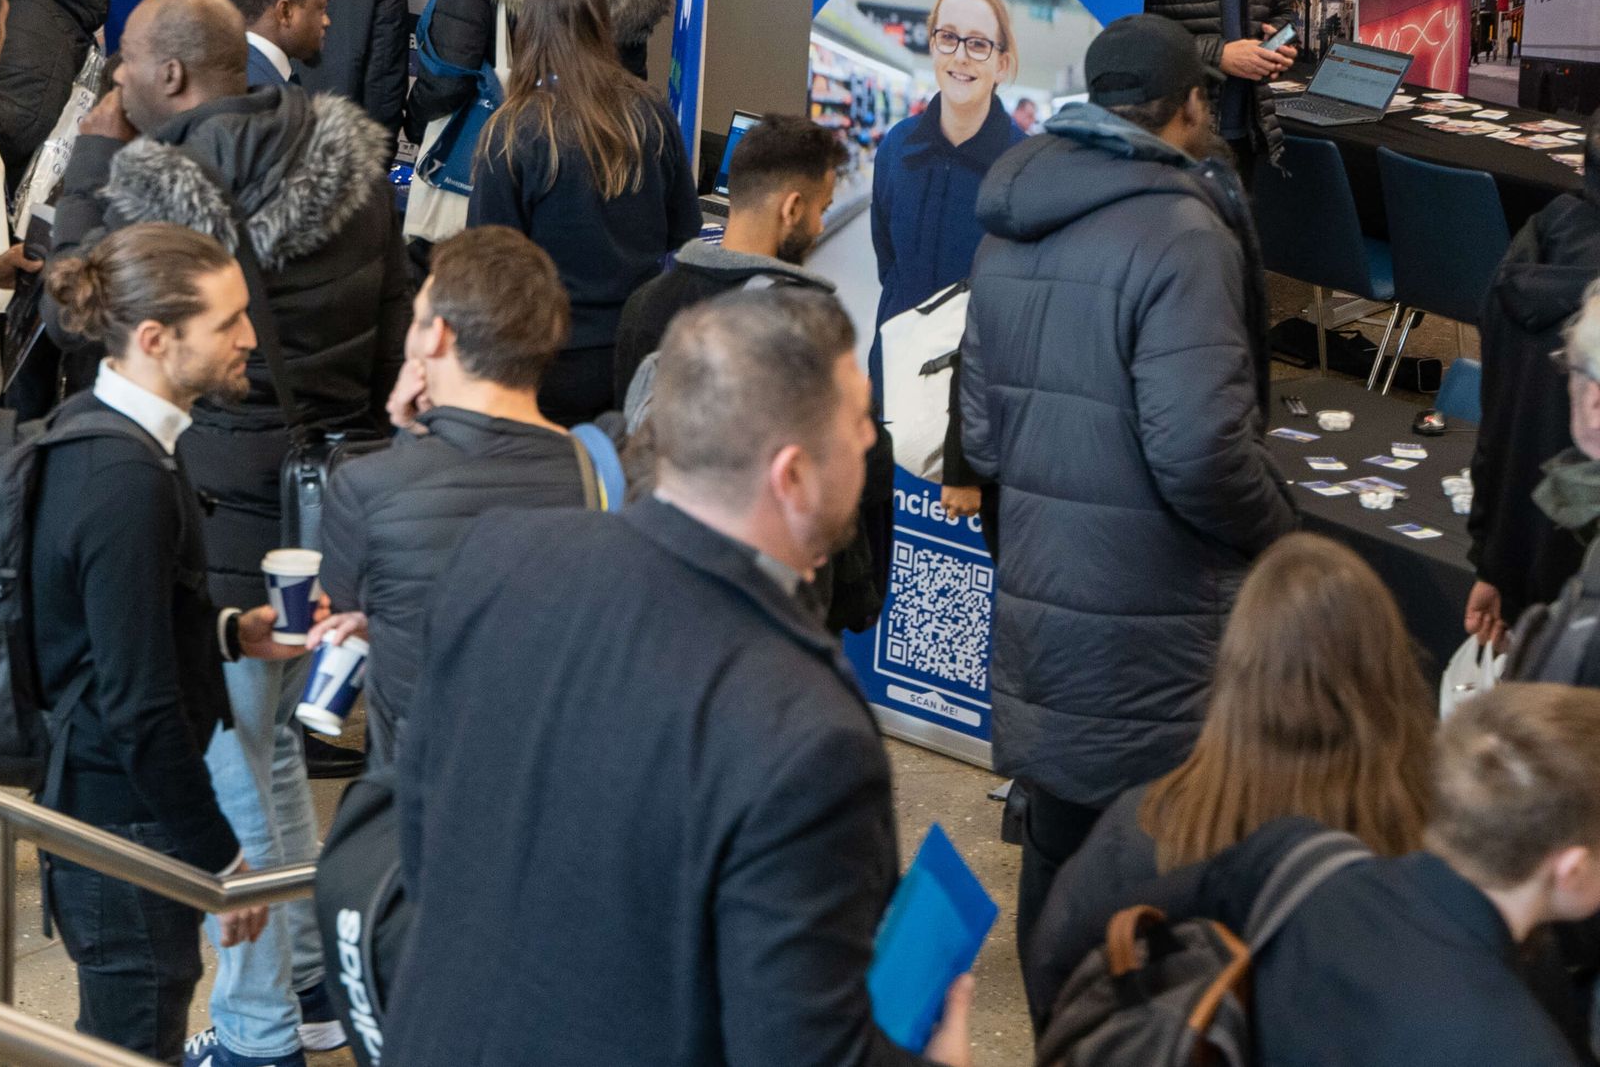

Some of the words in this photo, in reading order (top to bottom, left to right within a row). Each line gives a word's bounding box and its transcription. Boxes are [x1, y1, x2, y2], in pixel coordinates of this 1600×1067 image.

[910, 694, 937, 709] SCAN
[940, 703, 959, 716] ME!
[336, 907, 385, 1067] didas
